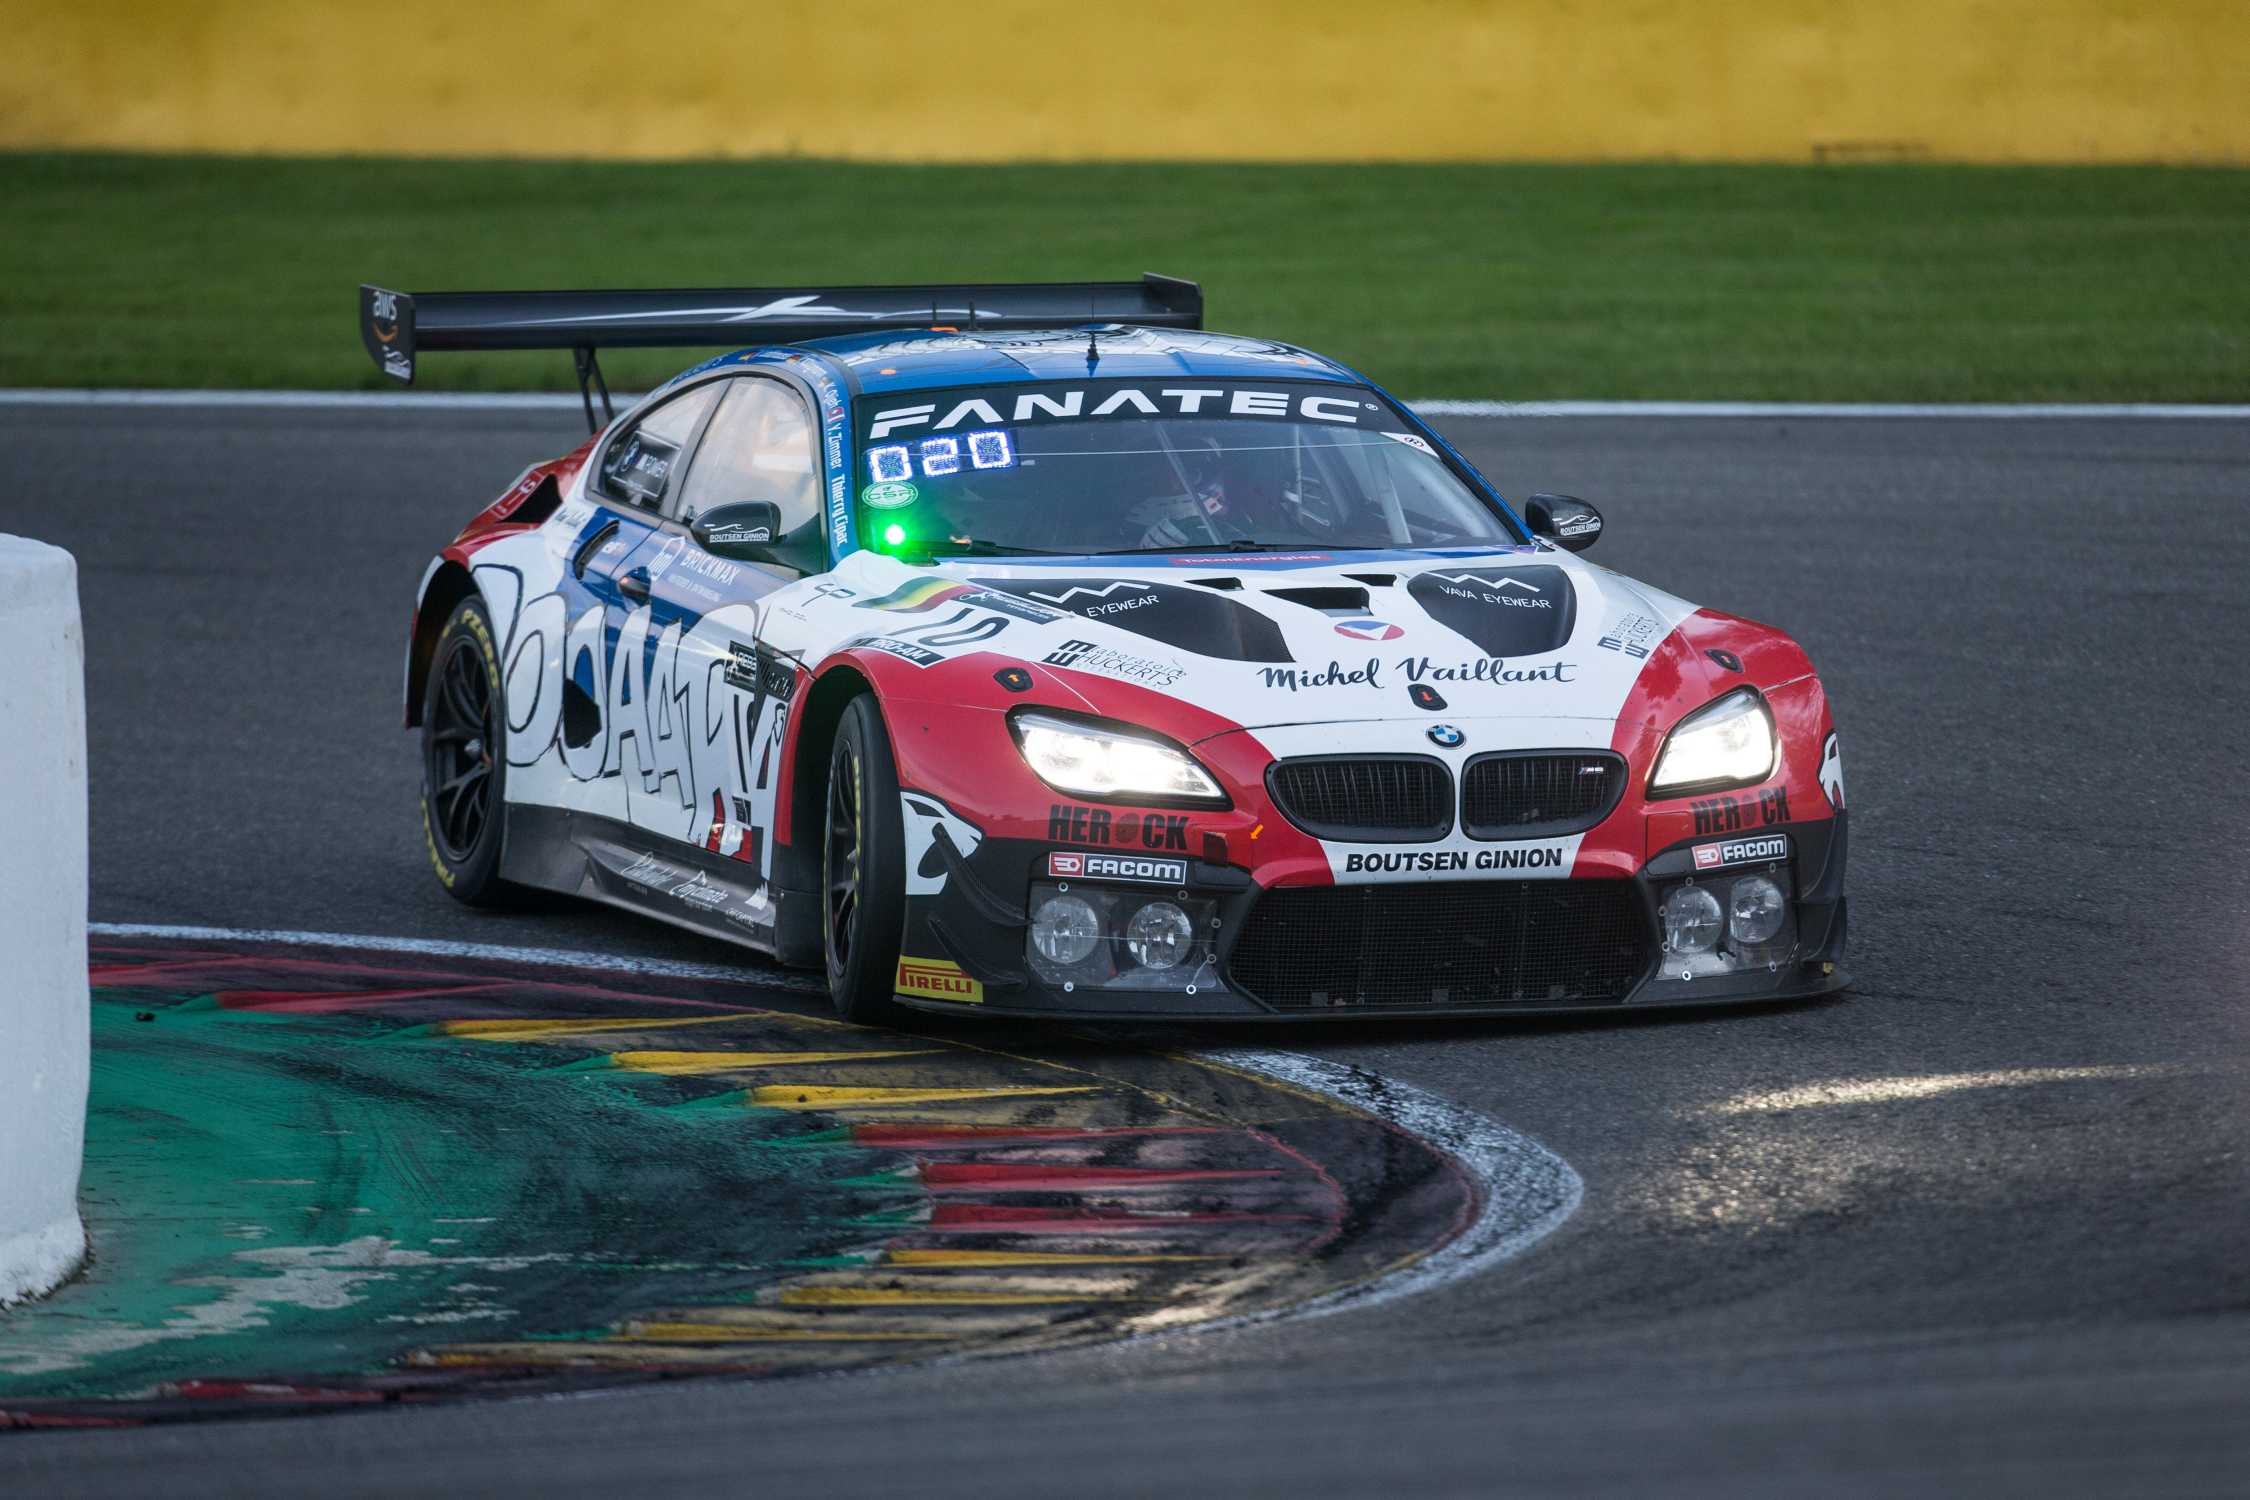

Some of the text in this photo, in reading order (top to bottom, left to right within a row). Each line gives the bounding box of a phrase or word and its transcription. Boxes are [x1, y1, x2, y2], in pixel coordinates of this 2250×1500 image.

[868, 389, 1359, 439] FANATEC
[710, 532, 769, 542] BOUTSEN GINION
[679, 549, 741, 586] BRICKMAX
[1086, 594, 1160, 618] EYEWEAR
[1439, 584, 1553, 609] VAVA EYEWEAR
[1256, 656, 1578, 692] Michel Vaillant
[1345, 847, 1563, 873] BOUTSEN GINION
[1723, 838, 1784, 861] FACOM
[1087, 858, 1182, 880] FACOM
[899, 963, 973, 994] PIRELLI
